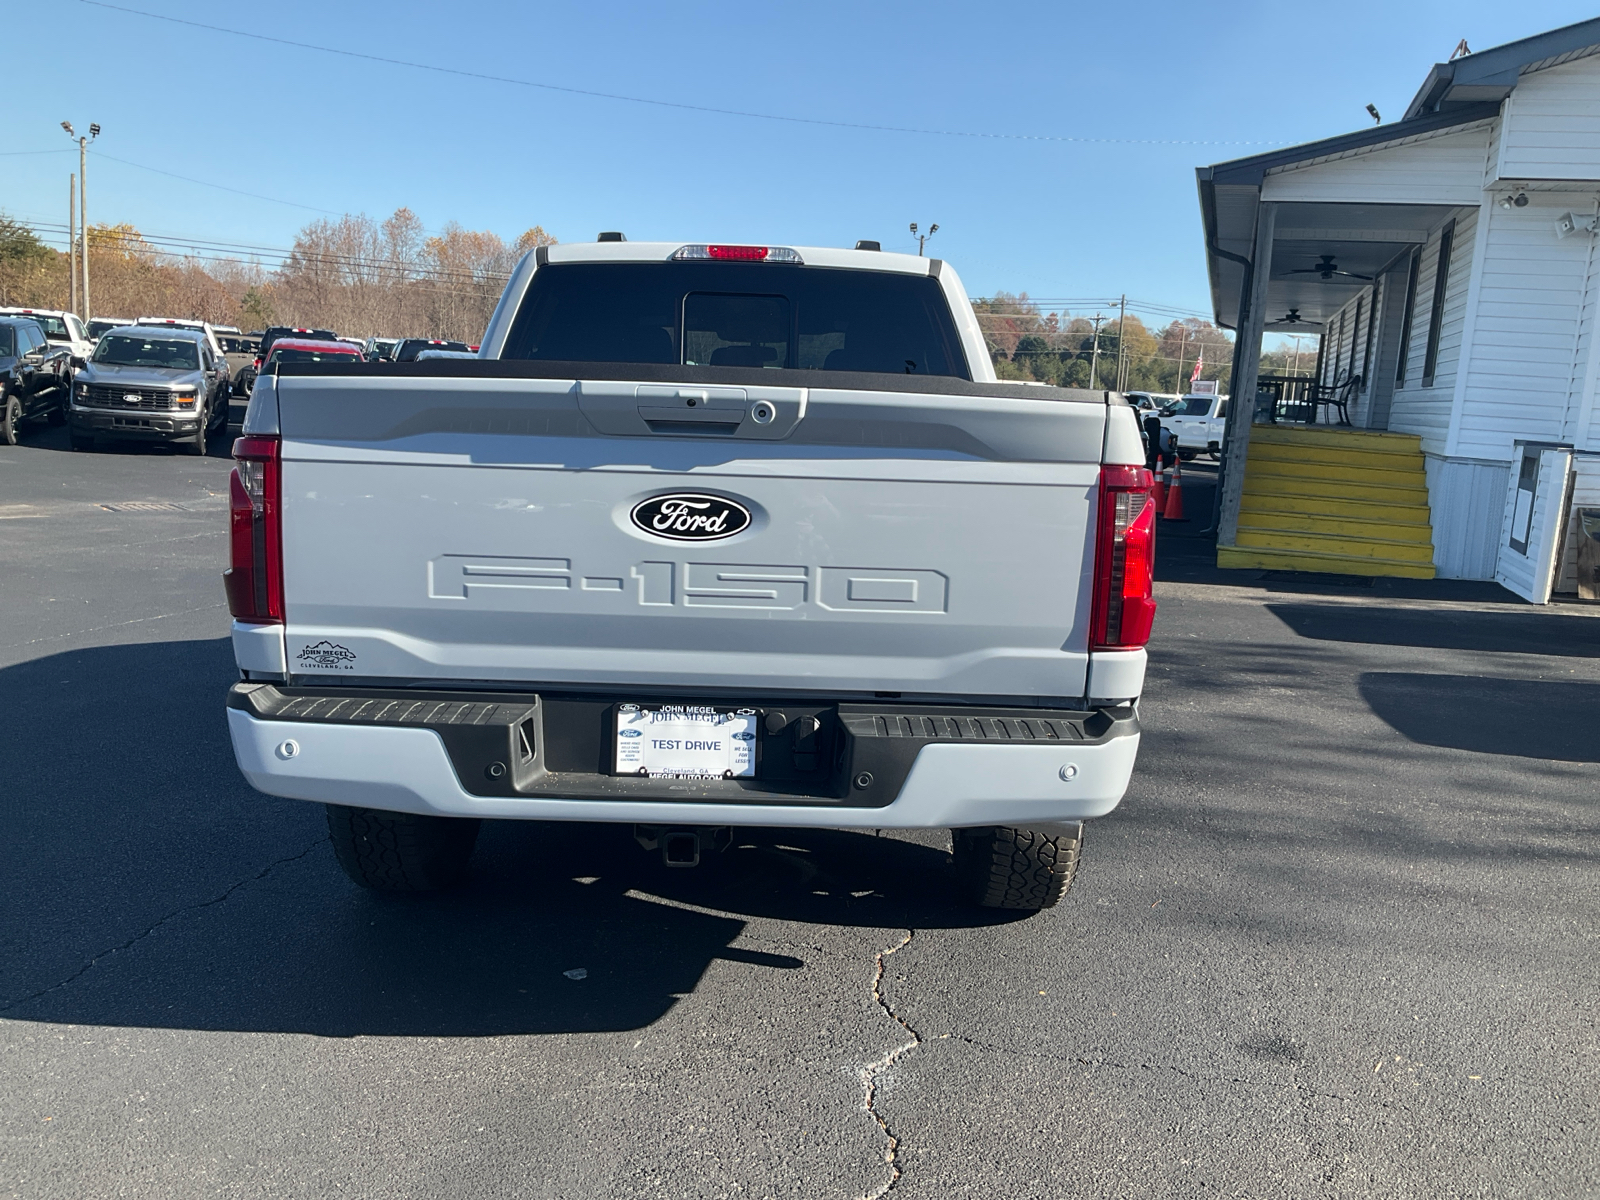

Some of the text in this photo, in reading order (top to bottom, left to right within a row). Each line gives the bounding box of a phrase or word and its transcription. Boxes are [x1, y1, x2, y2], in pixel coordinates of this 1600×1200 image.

[653, 500, 729, 532] Ford
[428, 554, 950, 613] F-150
[302, 649, 321, 657] JOHN
[660, 705, 716, 715] JOHN MEGEL
[650, 711, 681, 724] JOHN
[622, 729, 639, 738] Ford
[735, 732, 751, 740] Ford
[651, 740, 721, 751] TEST DRIVE
